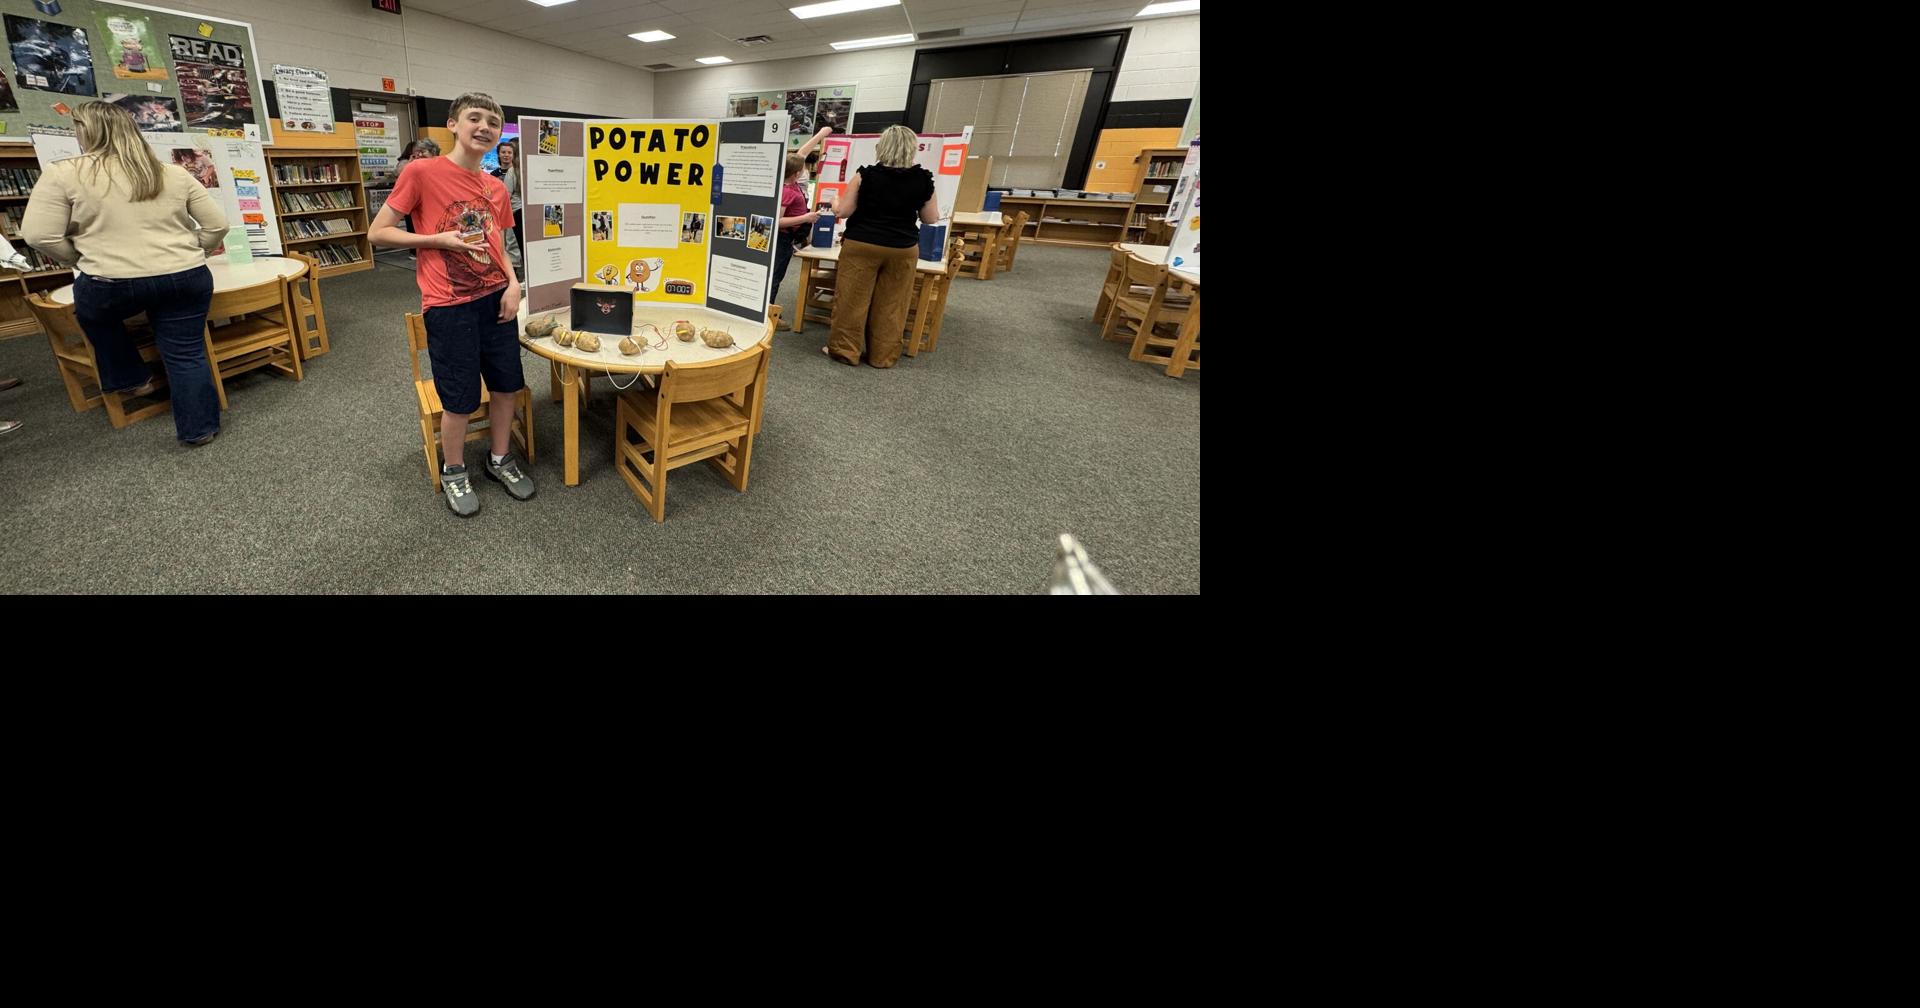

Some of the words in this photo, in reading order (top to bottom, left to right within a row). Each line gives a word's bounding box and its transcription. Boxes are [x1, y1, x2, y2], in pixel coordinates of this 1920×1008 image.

[173, 36, 242, 65] READ
[590, 125, 709, 153] POTATO
[771, 122, 779, 134] 9
[594, 159, 704, 186] POWER
